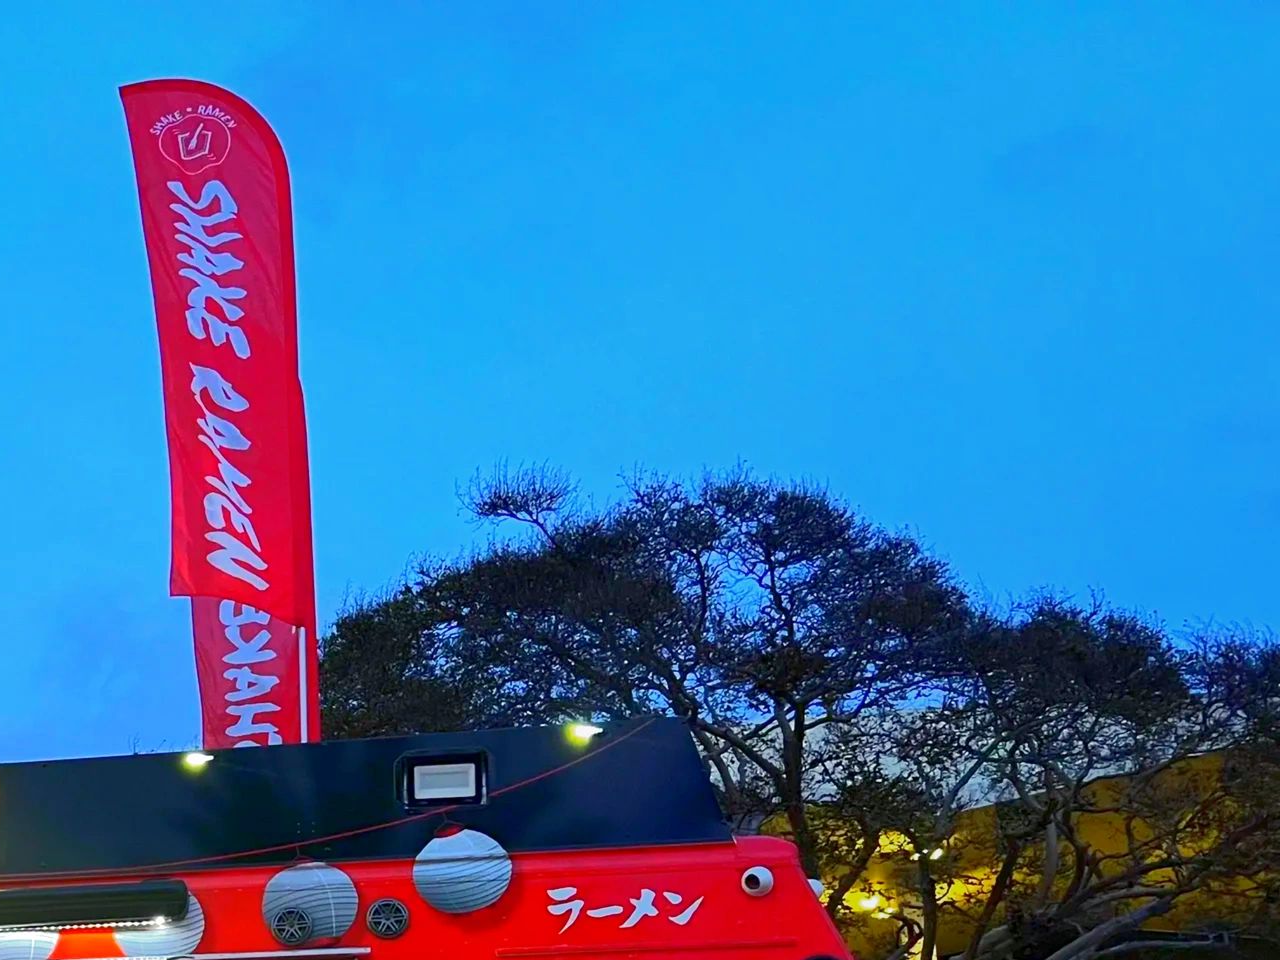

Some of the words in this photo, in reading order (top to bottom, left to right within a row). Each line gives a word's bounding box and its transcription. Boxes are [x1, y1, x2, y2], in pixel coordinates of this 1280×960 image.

[149, 110, 183, 136] SHAKE
[197, 104, 238, 128] RAMEN
[166, 179, 252, 359] SHAKE
[189, 361, 270, 591] RAMEN
[546, 886, 705, 935] ラーメン
